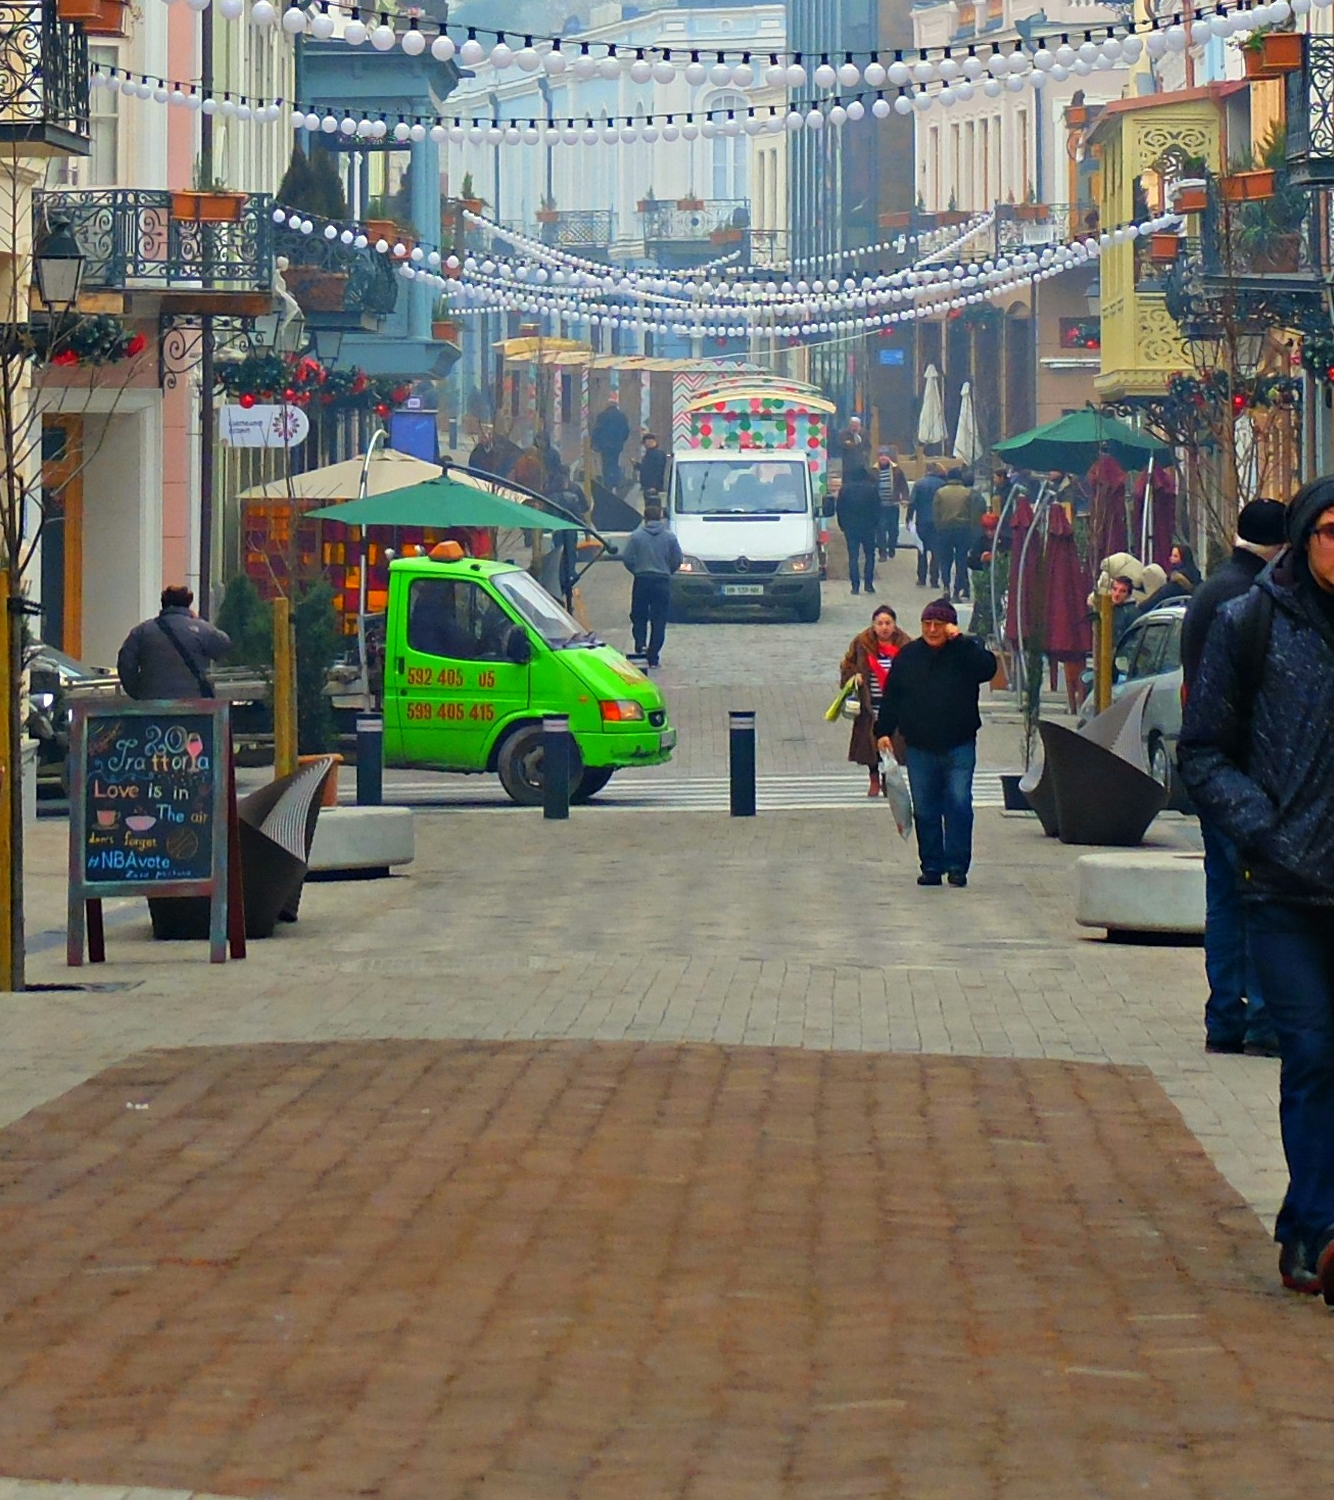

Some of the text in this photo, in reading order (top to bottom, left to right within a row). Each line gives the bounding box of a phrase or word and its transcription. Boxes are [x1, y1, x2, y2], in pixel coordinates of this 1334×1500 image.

[408, 667, 431, 685] 592
[437, 703, 464, 720] 405
[469, 703, 494, 720] 415
[94, 780, 189, 800] Love is in
[156, 803, 209, 825] The air
